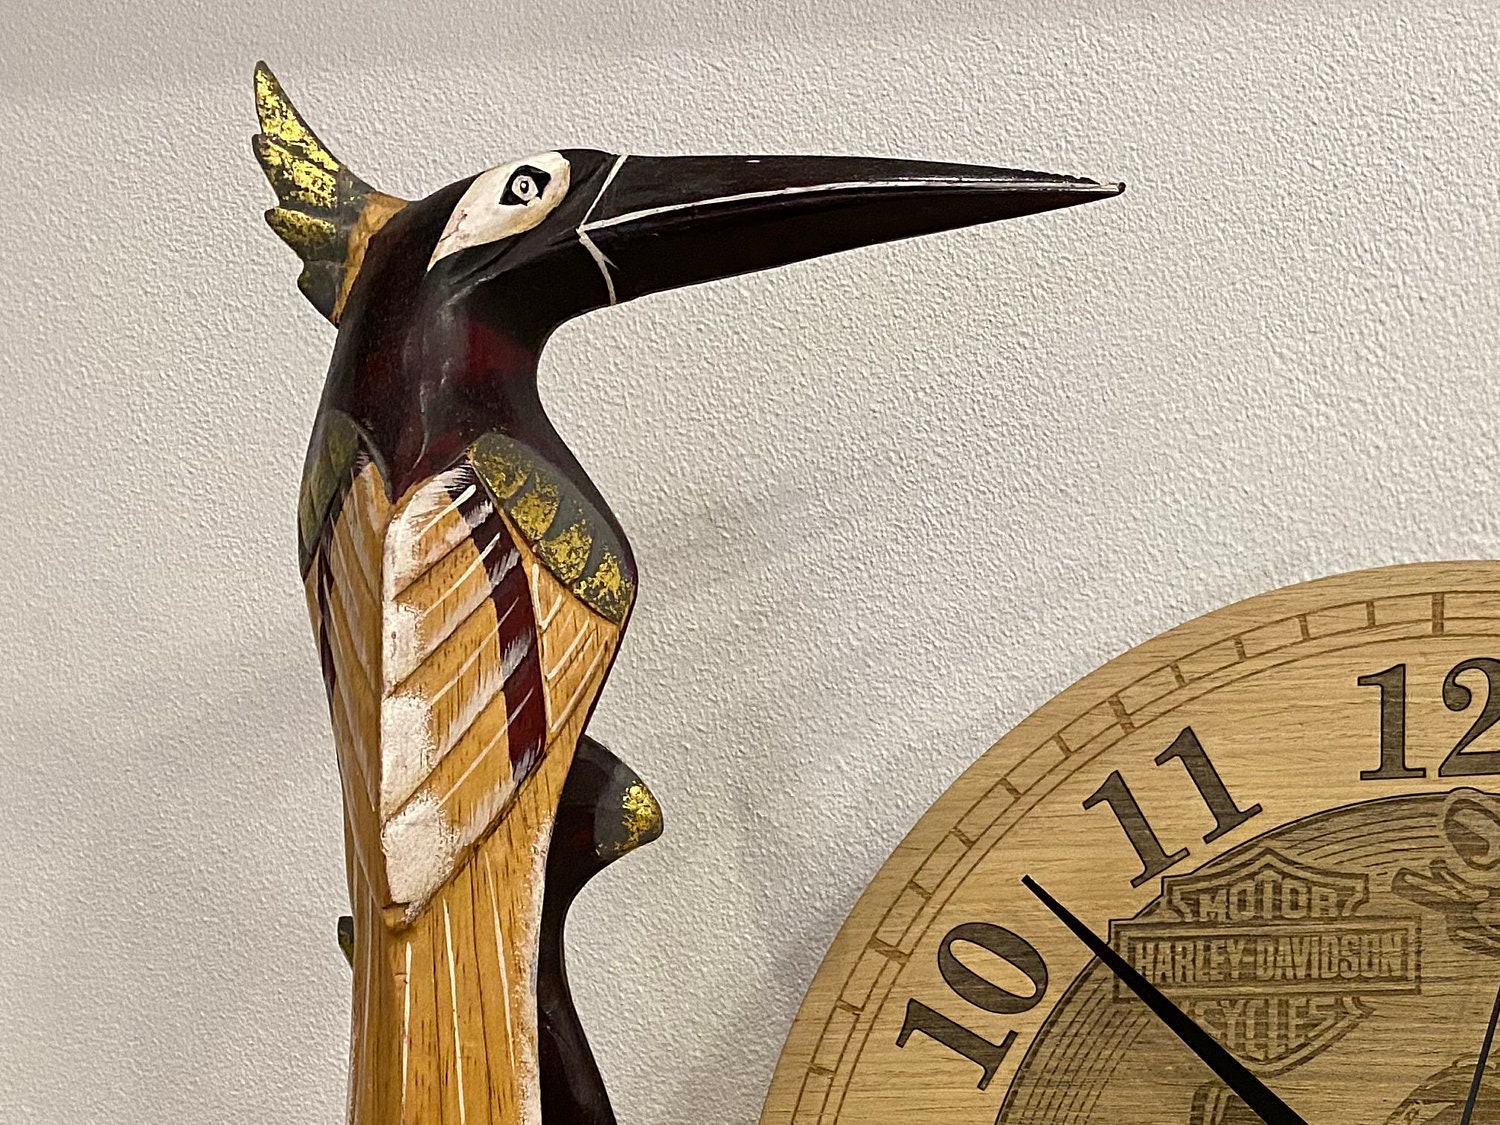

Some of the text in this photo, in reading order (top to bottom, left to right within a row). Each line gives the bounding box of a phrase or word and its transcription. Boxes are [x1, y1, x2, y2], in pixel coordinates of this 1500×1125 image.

[1082, 725, 1263, 888] 11
[1198, 870, 1339, 922] MOTOR
[895, 921, 1049, 1091] 10
